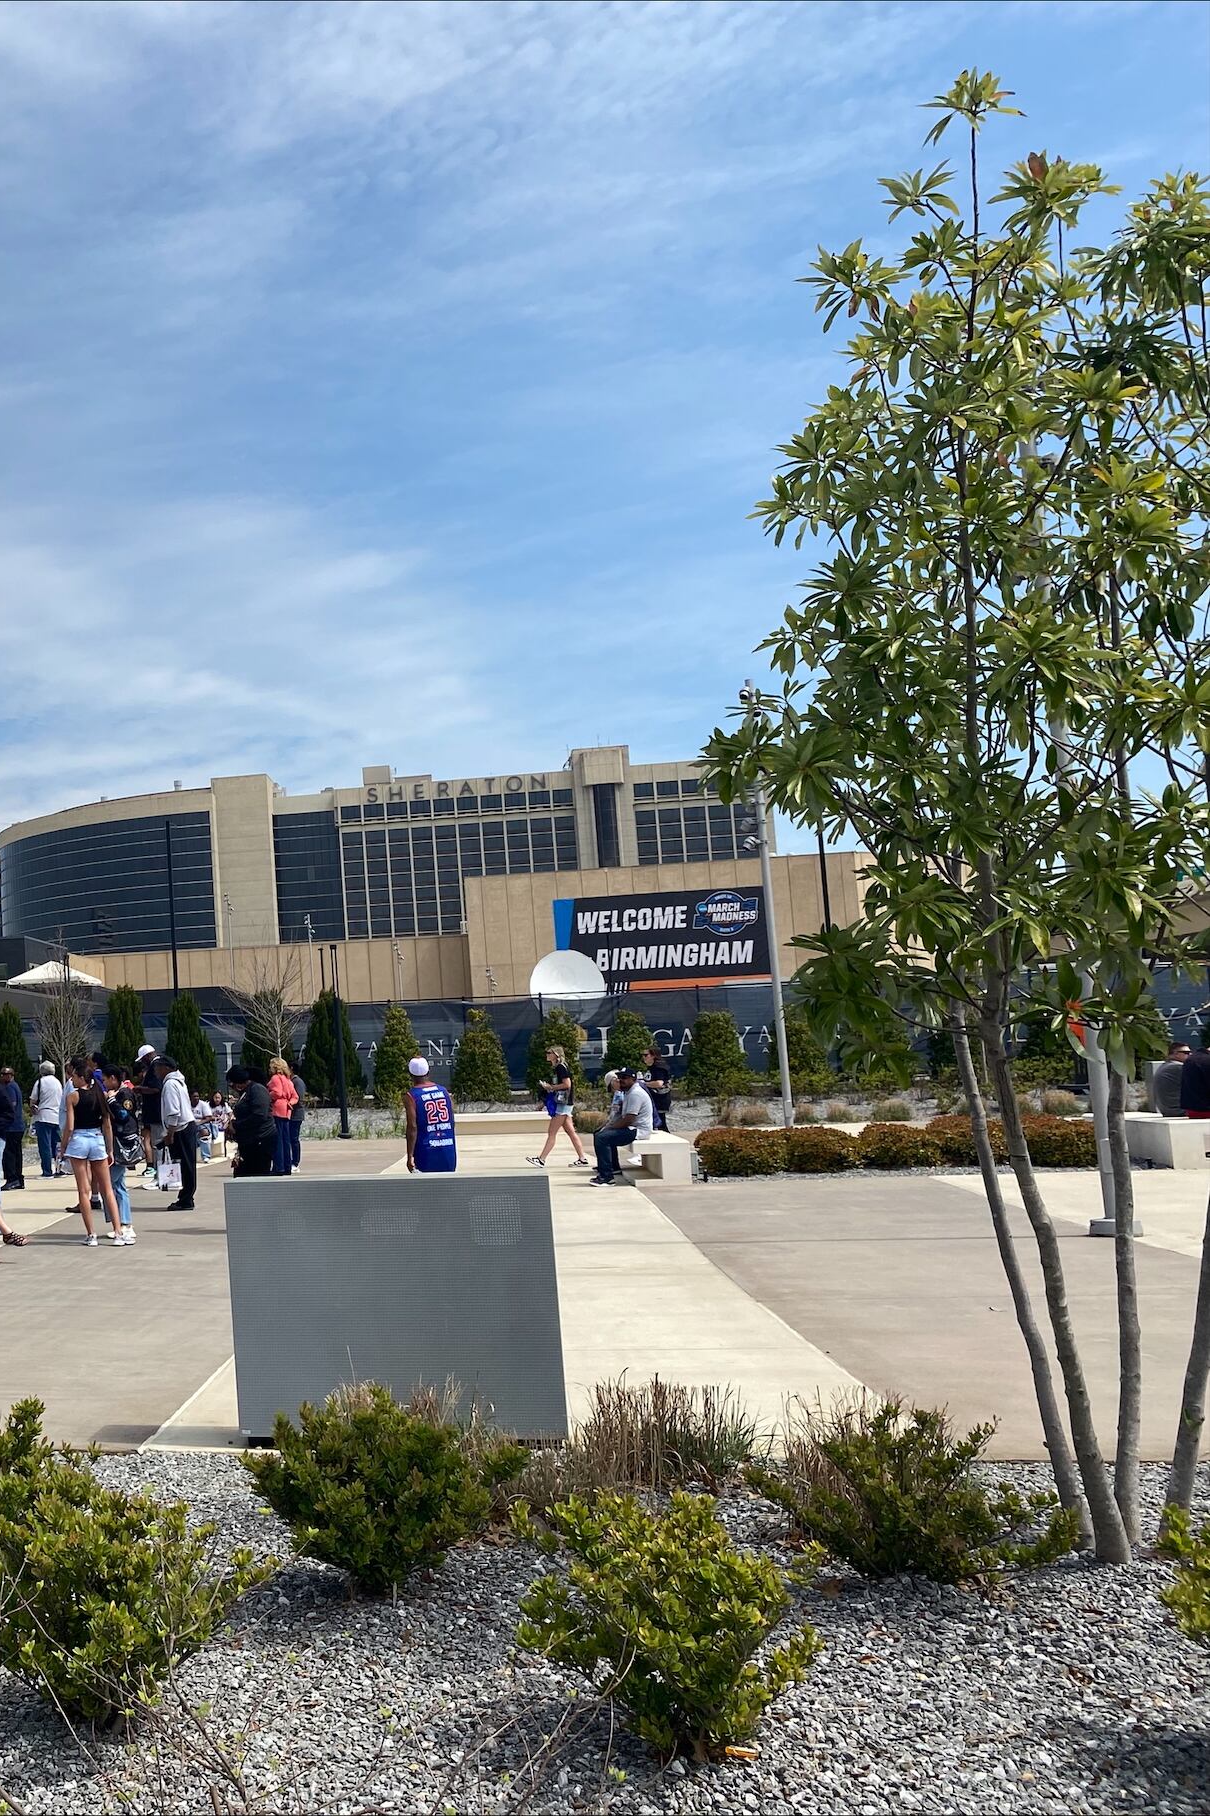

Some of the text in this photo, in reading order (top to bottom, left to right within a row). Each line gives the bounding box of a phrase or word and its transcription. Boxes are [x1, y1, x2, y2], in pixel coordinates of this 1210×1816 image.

[367, 774, 546, 803] SHERATON
[577, 906, 687, 934] WELCOME
[708, 902, 740, 913] MARCH
[712, 910, 756, 922] MADNESS
[596, 940, 754, 972] BIRMINGHAM
[425, 1099, 450, 1124] 25
